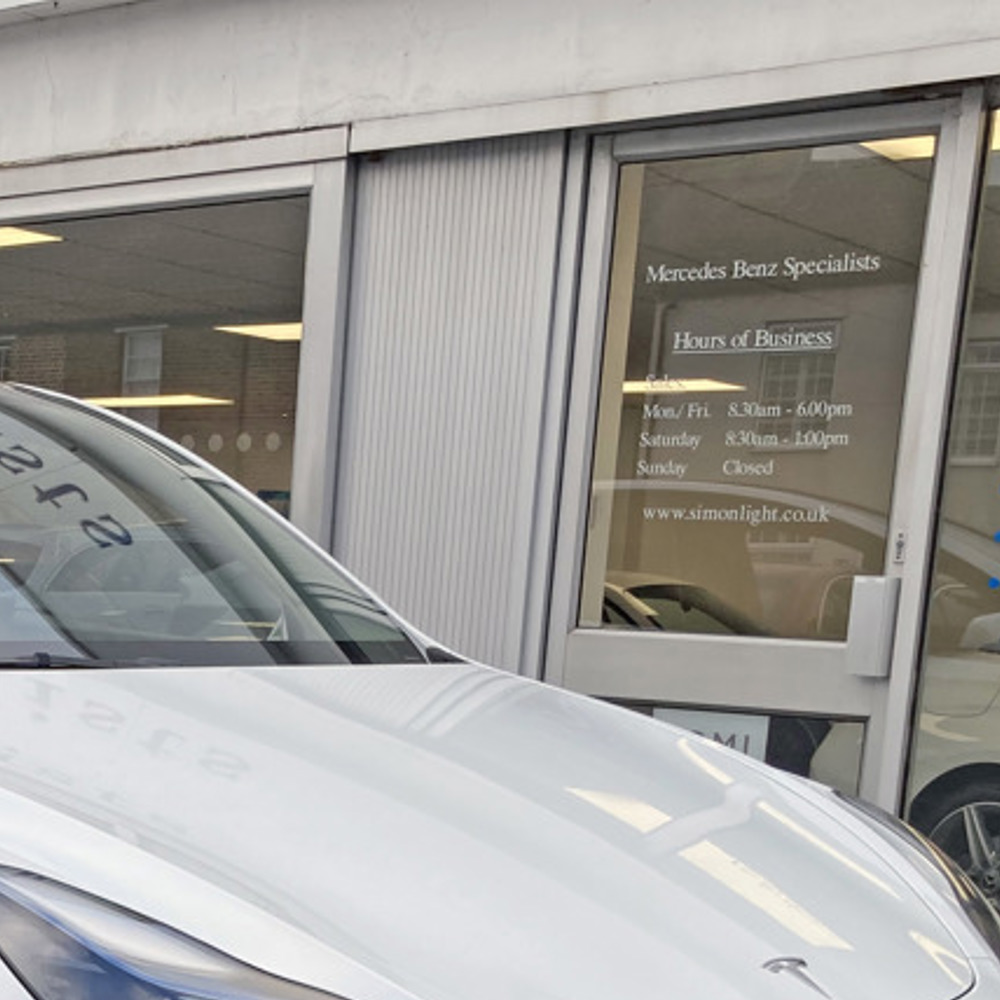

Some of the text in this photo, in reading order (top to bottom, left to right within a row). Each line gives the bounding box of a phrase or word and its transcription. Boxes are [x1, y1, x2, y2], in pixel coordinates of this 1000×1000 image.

[645, 247, 881, 284] Mercedes Benz Specialists
[673, 326, 834, 350] Hours of Business
[639, 431, 702, 451] Saturday
[636, 459, 773, 479] Sunday Closed
[643, 504, 830, 527] www.simonlight.co.uk
